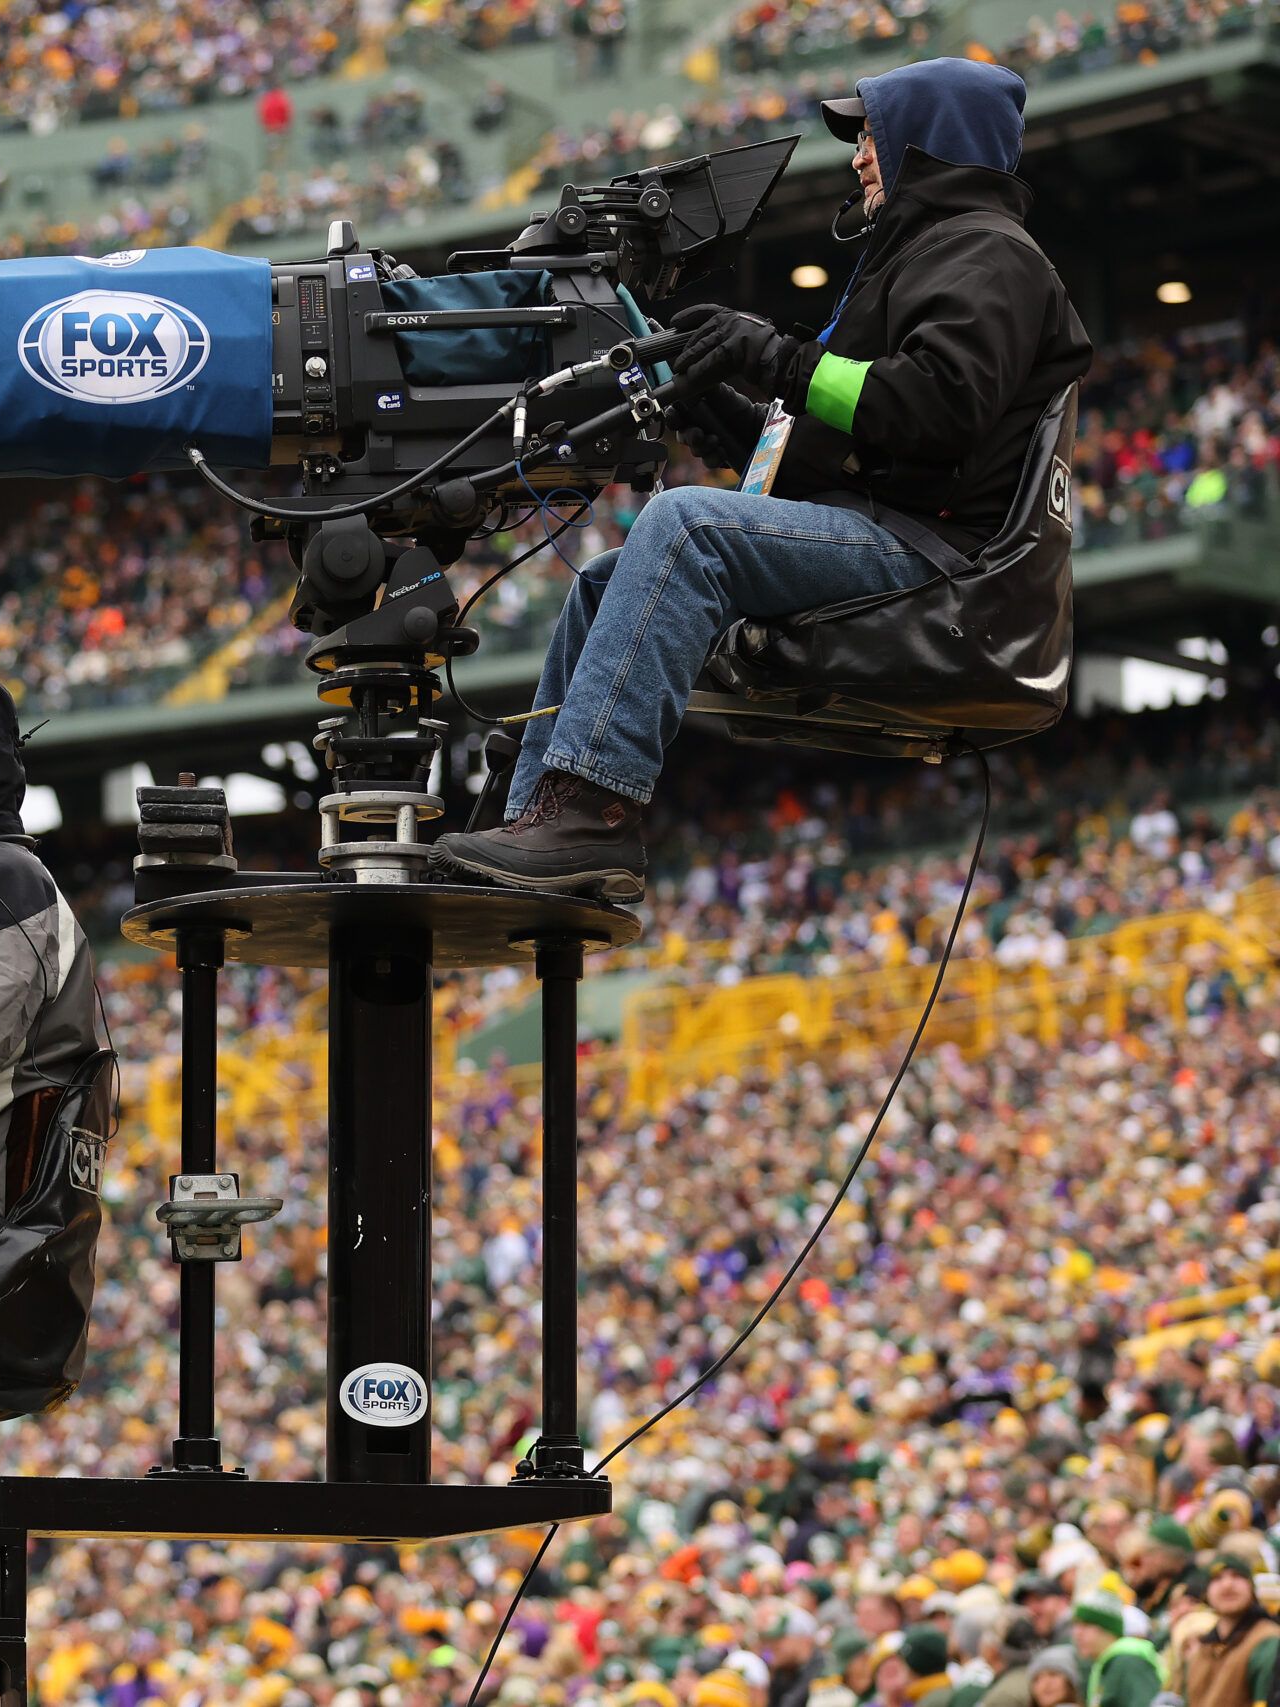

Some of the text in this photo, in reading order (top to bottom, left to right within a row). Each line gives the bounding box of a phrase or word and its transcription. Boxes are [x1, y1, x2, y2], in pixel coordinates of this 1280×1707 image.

[387, 315, 430, 325] SONY
[61, 311, 167, 357] FOX
[61, 358, 168, 378] SPORTS
[388, 571, 441, 599] Vector 750
[363, 1378, 410, 1402] FOX
[362, 1400, 411, 1411] SPORTS
